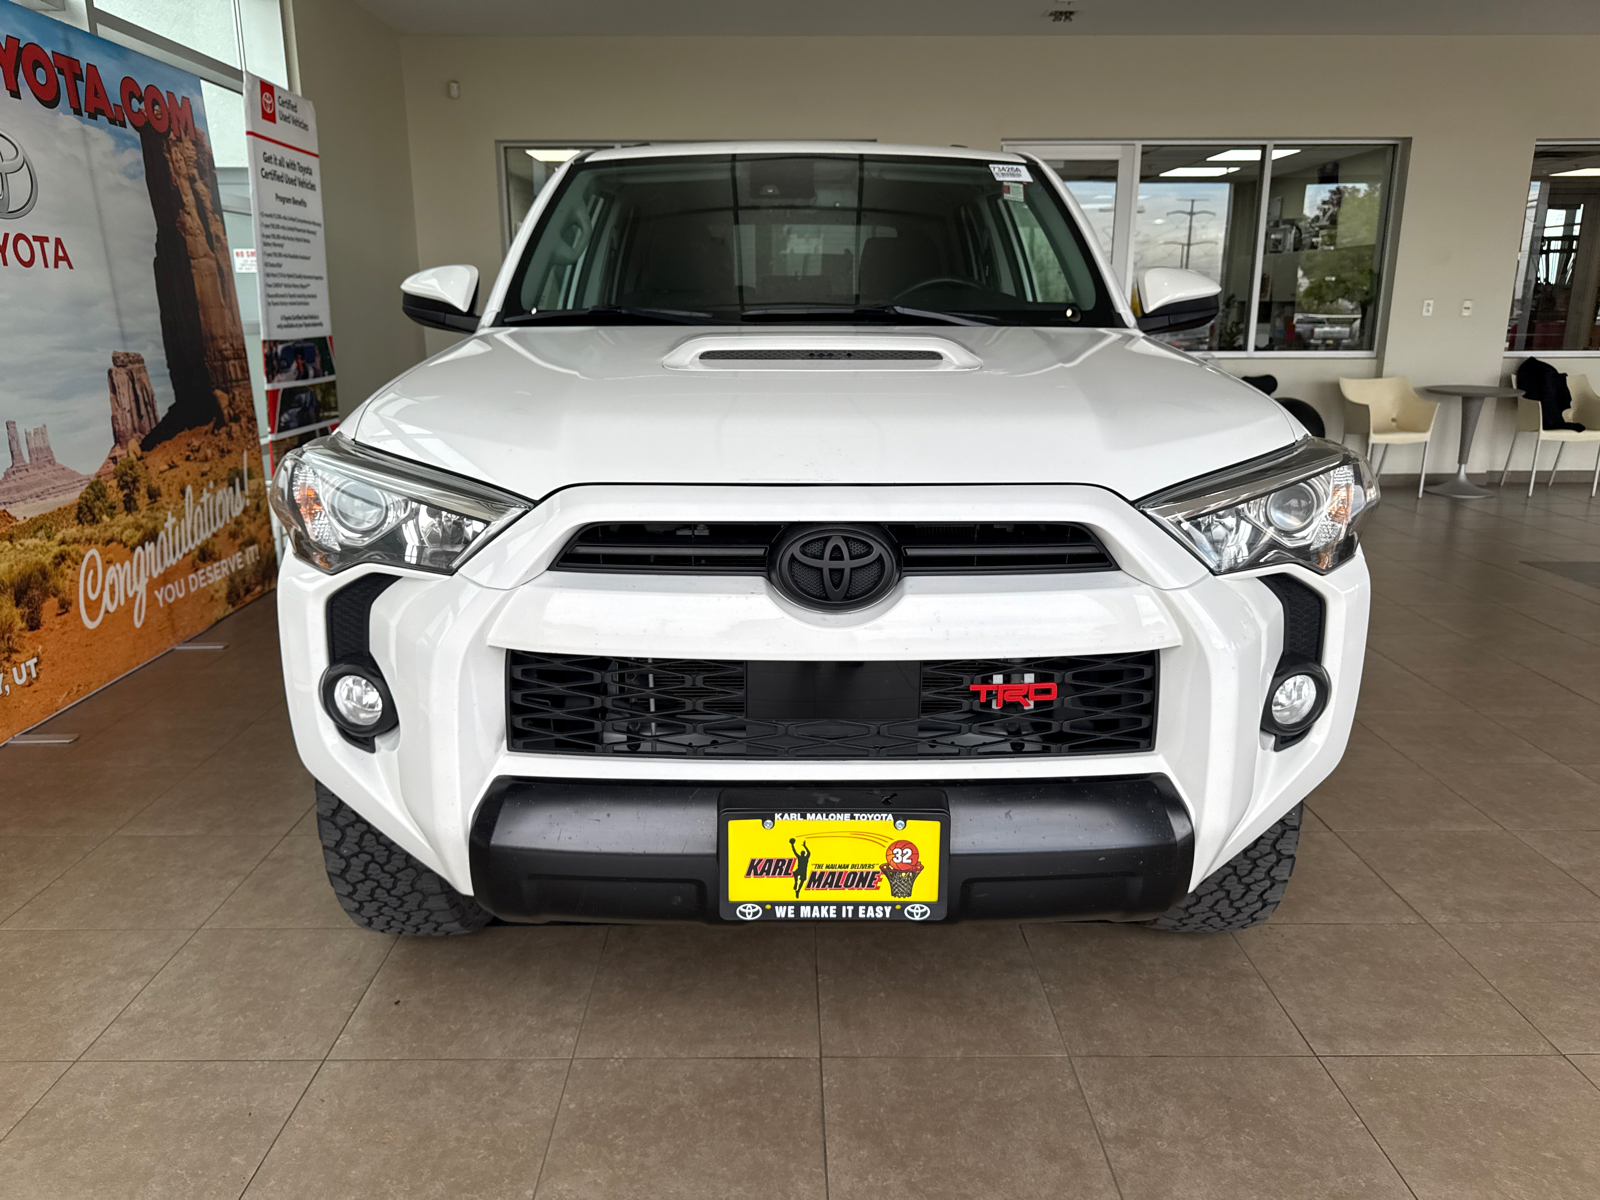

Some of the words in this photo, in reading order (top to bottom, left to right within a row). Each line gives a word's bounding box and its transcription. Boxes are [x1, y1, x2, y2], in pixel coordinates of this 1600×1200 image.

[79, 449, 250, 630] Congratulations!
[154, 581, 186, 607] YOU
[188, 554, 245, 593] DESERVE
[245, 543, 260, 566] IT!
[12, 656, 38, 685] UT
[969, 682, 1058, 708] TRD
[774, 813, 804, 821] KARL
[806, 813, 851, 821] MALONE
[853, 813, 894, 822] TOYOTA
[892, 847, 912, 864] 32
[745, 858, 797, 878] KARL
[805, 870, 884, 891] MALONE
[774, 906, 795, 918] WE
[800, 906, 837, 918] MAKE
[841, 906, 854, 918] IT
[858, 906, 892, 918] EASY
